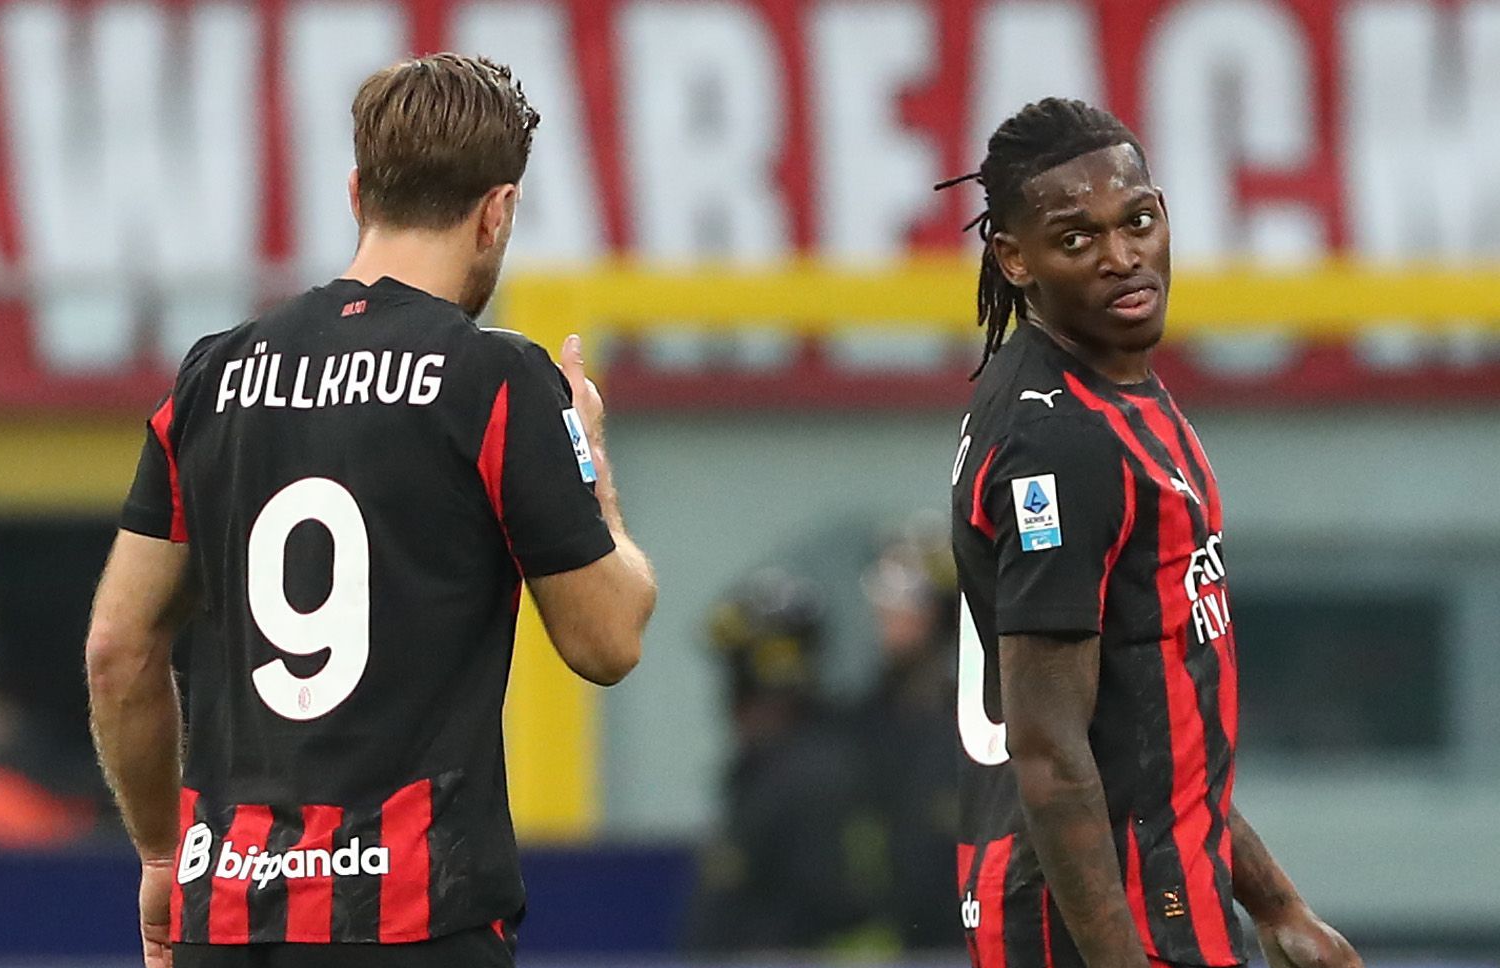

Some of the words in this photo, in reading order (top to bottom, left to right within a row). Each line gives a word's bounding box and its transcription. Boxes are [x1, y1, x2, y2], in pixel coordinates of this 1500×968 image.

[215, 342, 446, 413] FÜLLKRUG
[247, 476, 370, 722] 9
[215, 837, 389, 891] bitpanda
